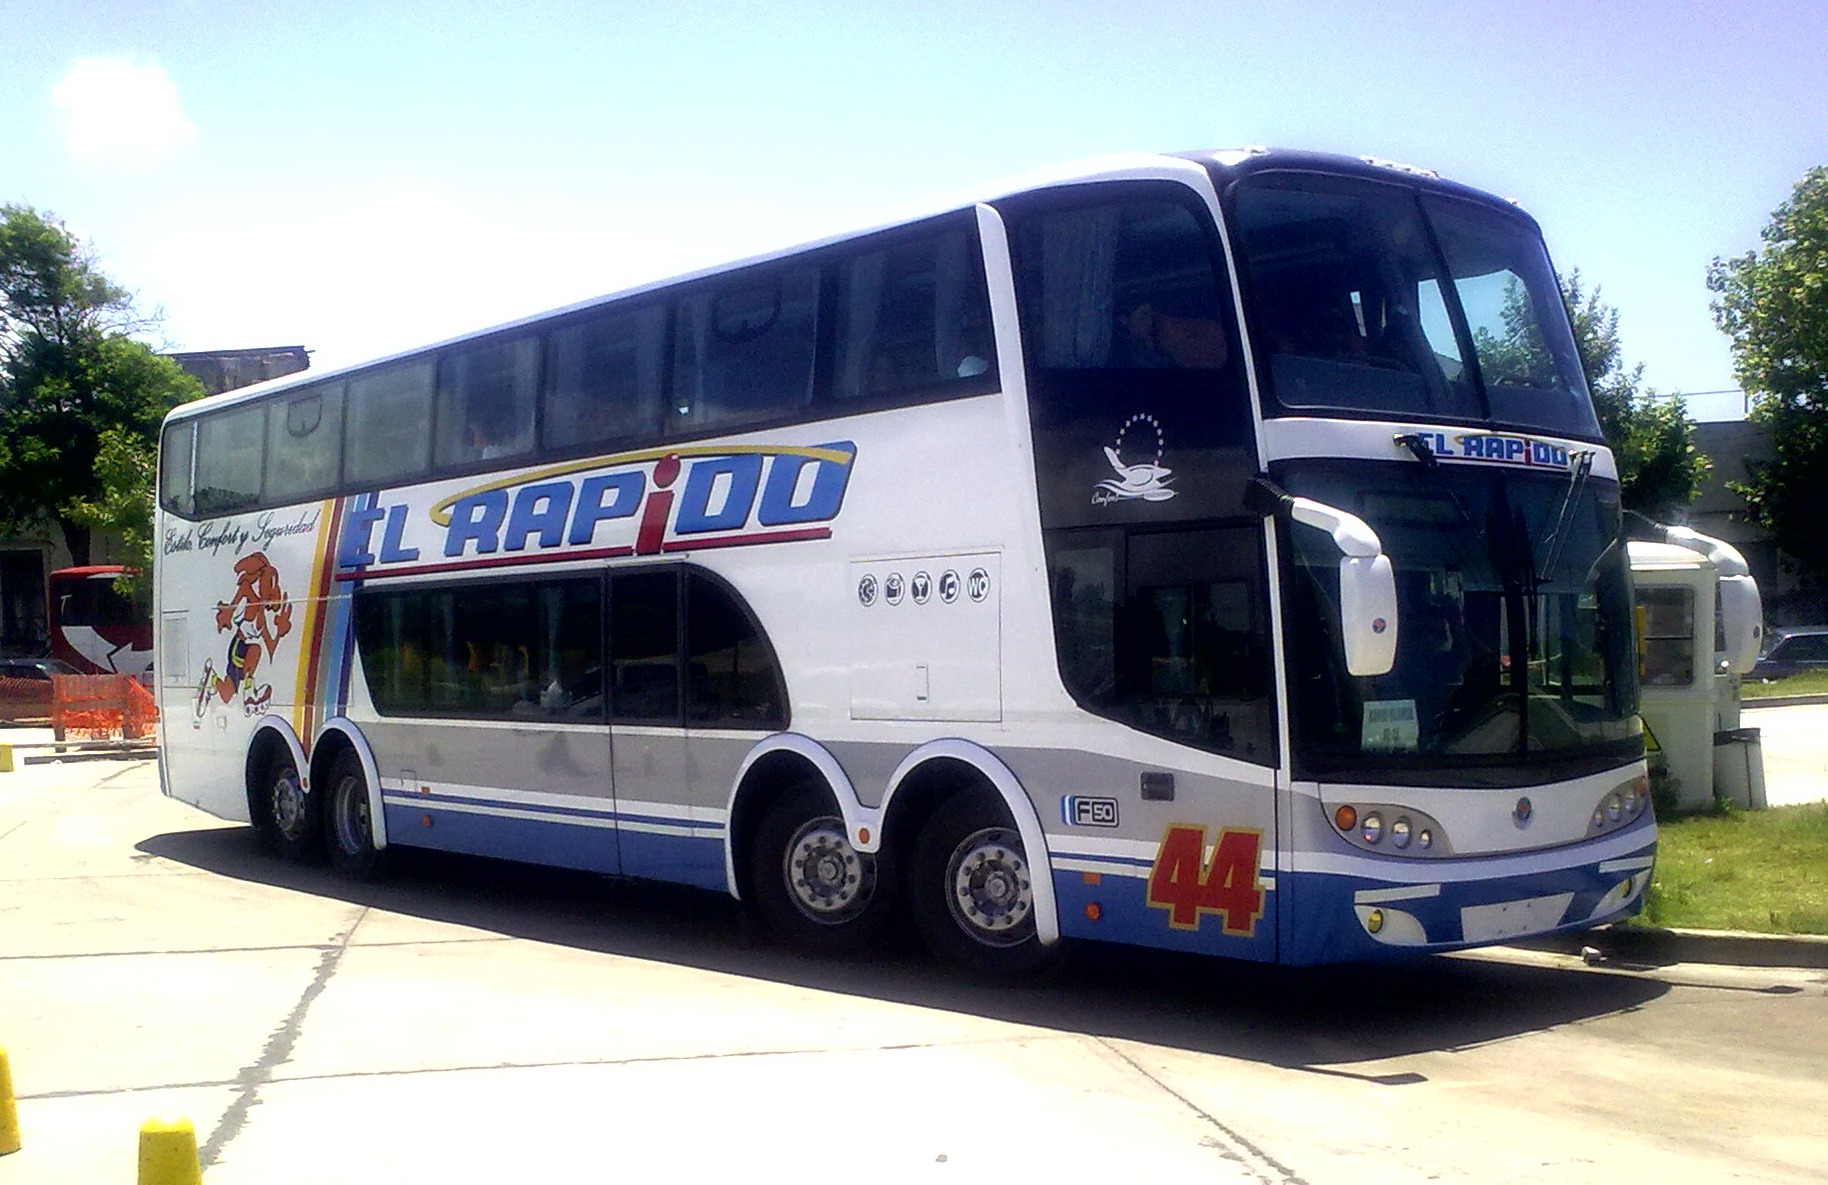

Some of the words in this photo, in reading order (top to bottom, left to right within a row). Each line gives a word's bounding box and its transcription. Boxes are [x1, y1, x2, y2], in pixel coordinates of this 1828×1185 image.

[234, 531, 249, 556] y
[252, 509, 321, 552] Seguridad
[339, 505, 421, 568] EL
[968, 576, 990, 597] WC
[1146, 822, 1267, 937] 44
